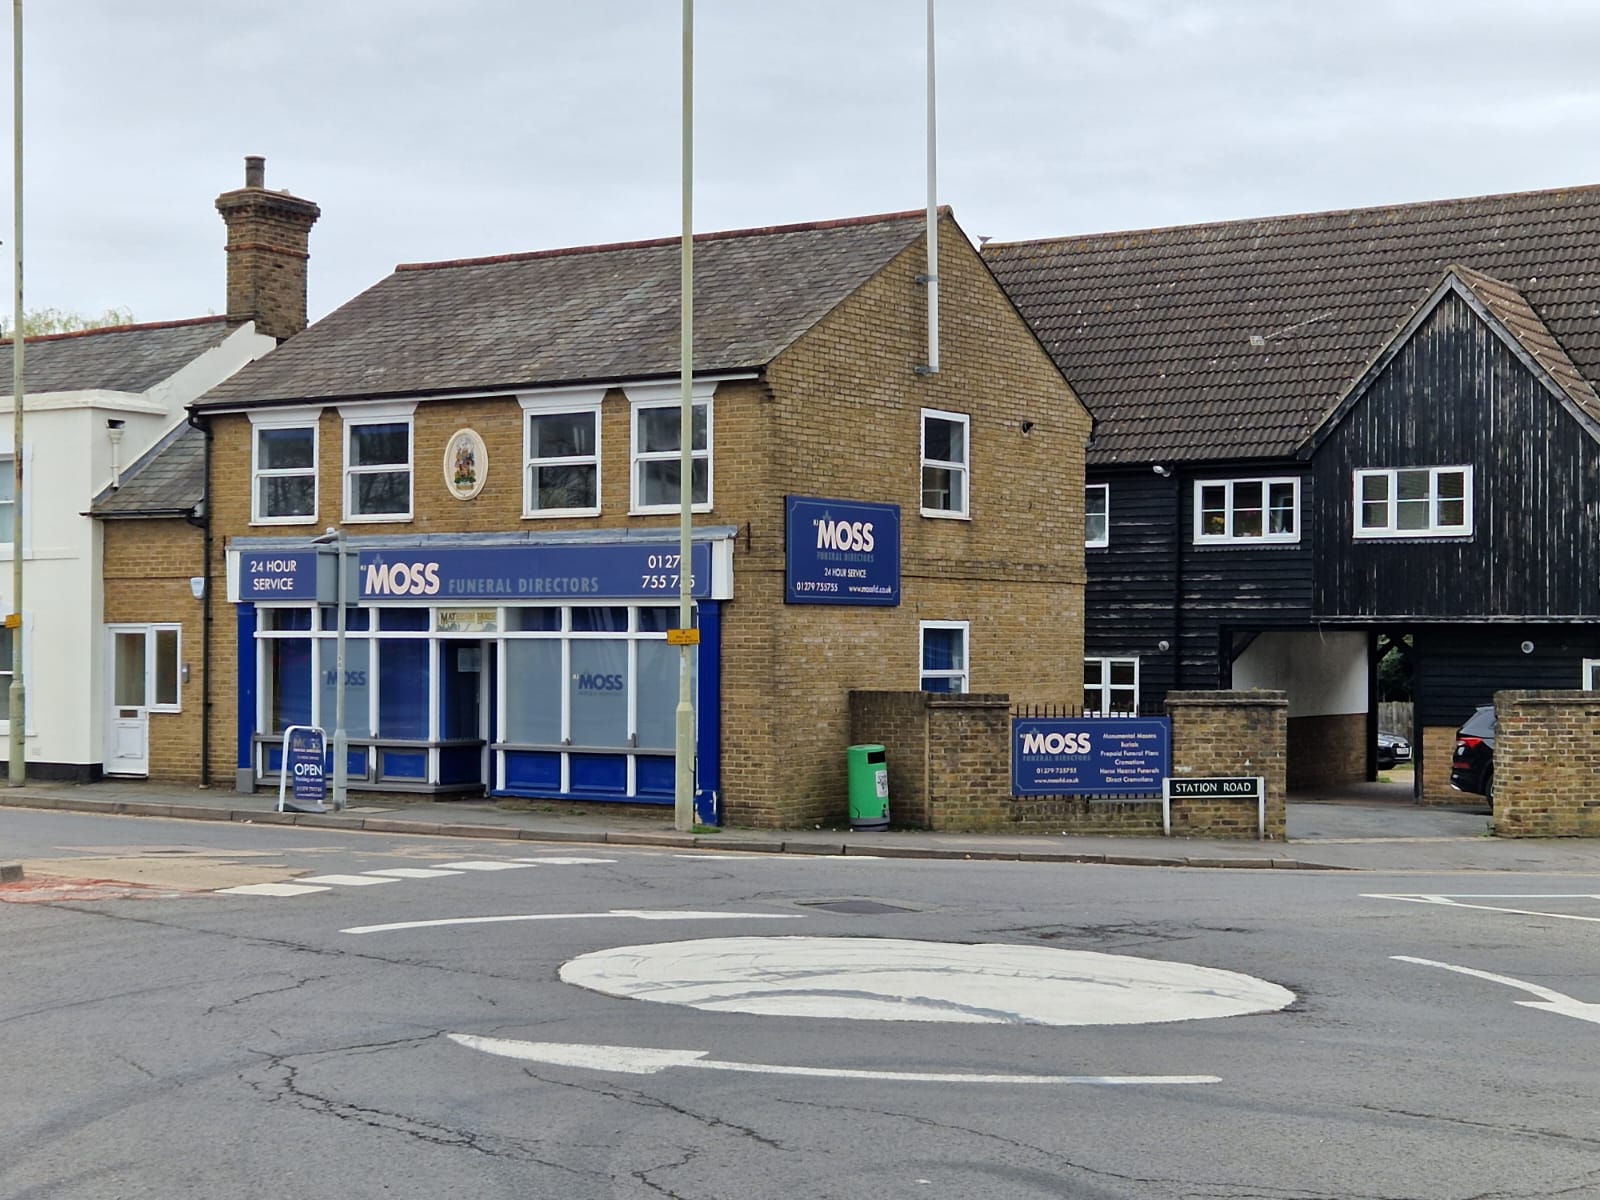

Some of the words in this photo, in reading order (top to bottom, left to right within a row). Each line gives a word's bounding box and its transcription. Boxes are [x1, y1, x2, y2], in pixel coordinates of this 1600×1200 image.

[817, 520, 874, 551] MOSS
[250, 560, 263, 573] 24
[266, 560, 297, 572] HOUR
[648, 555, 681, 569] 0127
[365, 562, 440, 595] MOSS
[449, 579, 512, 594] FUNERAL
[518, 577, 599, 593] DIRECTORS
[824, 568, 832, 576] 24
[832, 568, 847, 577] HOUR
[847, 569, 867, 578] SERVICE
[253, 578, 294, 591] SERVICE
[642, 575, 667, 589] 755
[796, 582, 815, 591] 01279
[578, 674, 623, 690] MOSS
[1023, 733, 1091, 754] MOSS
[295, 763, 322, 776] OPEN
[1175, 782, 1217, 793] STATION
[1223, 782, 1251, 792] ROAD
